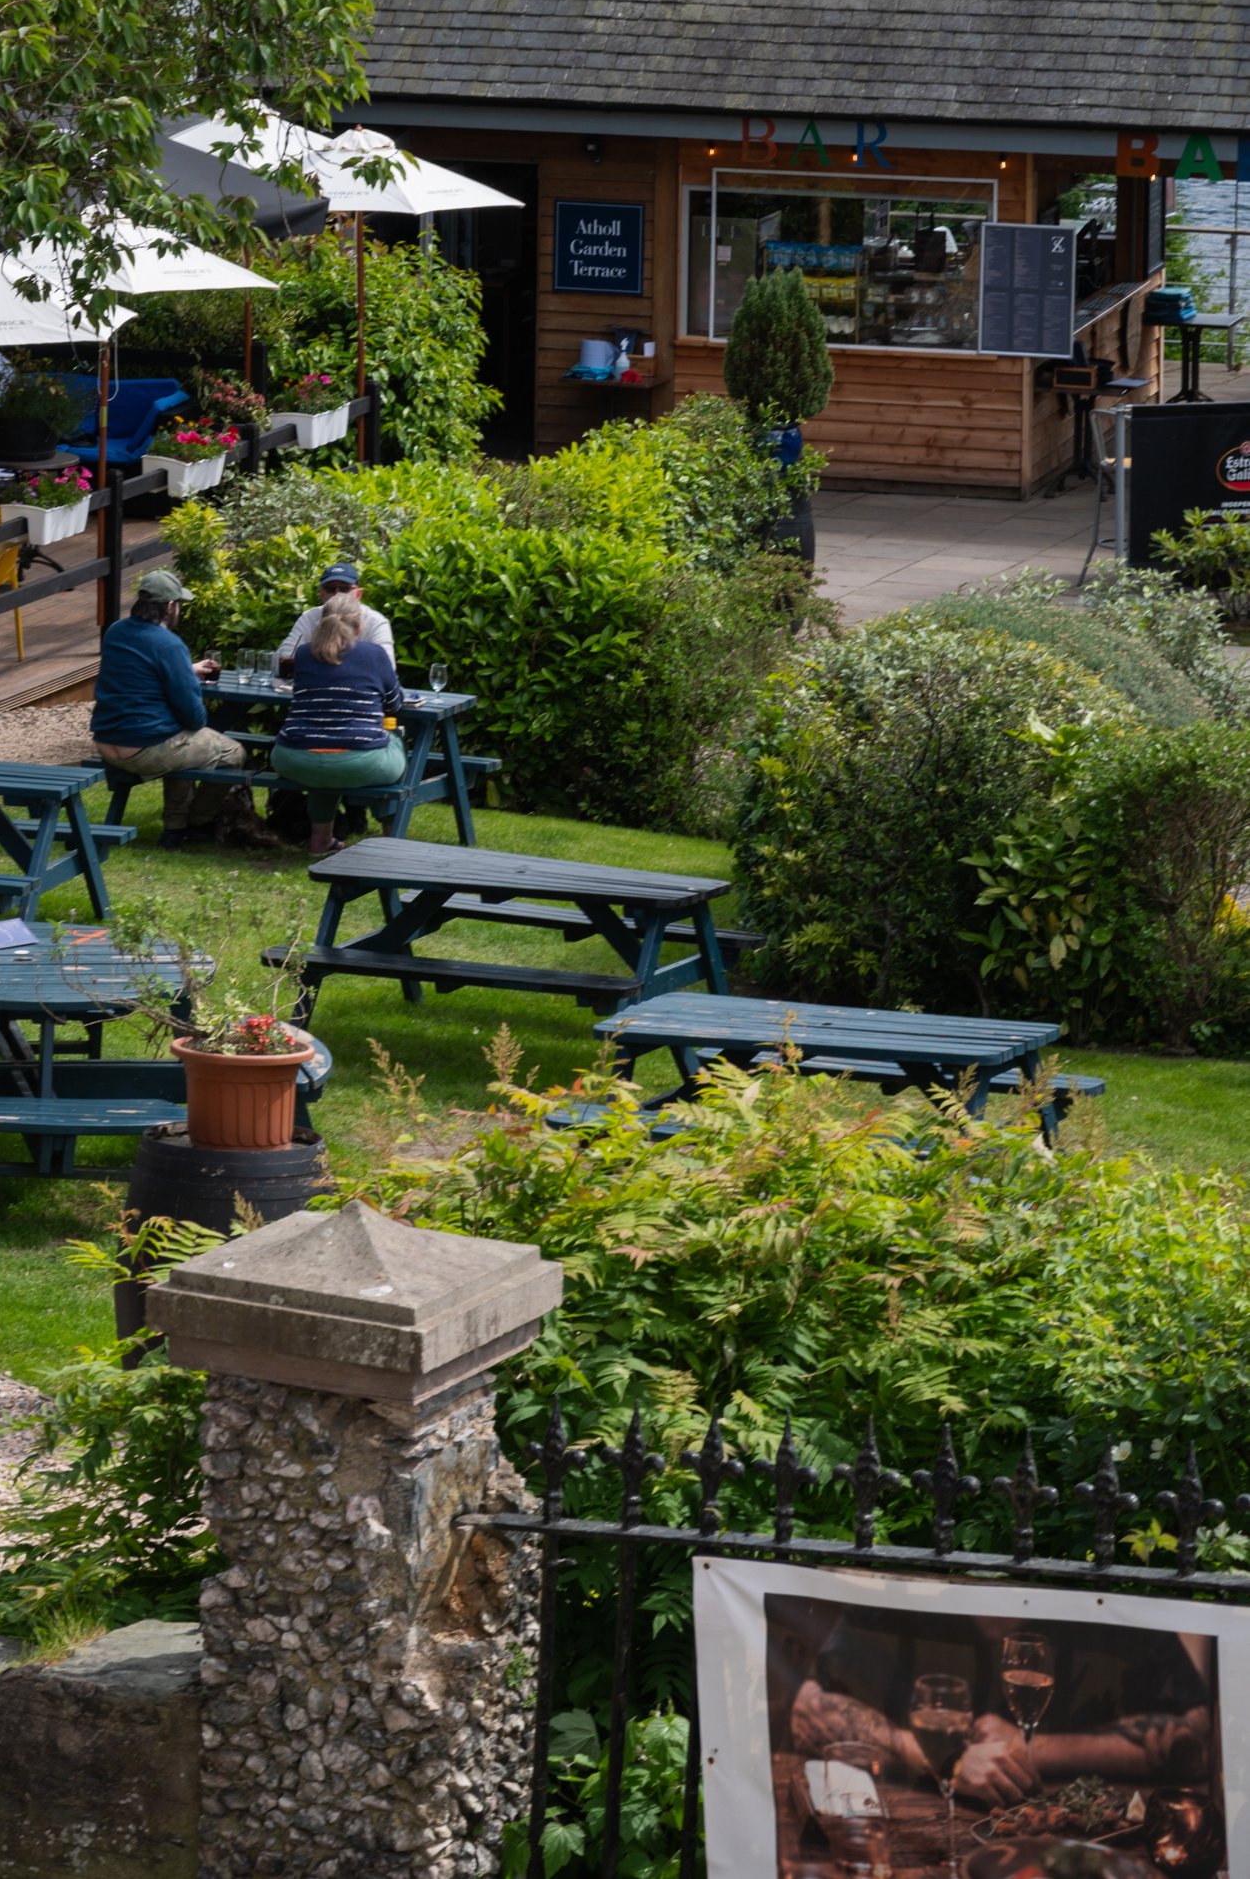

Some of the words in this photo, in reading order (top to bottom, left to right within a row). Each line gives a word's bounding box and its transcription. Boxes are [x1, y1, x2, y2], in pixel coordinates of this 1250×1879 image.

[739, 116, 893, 169] BAR
[1116, 131, 1250, 183] BA
[575, 218, 622, 237] Atholl
[569, 239, 628, 258] Garden
[568, 260, 628, 279] Terrace
